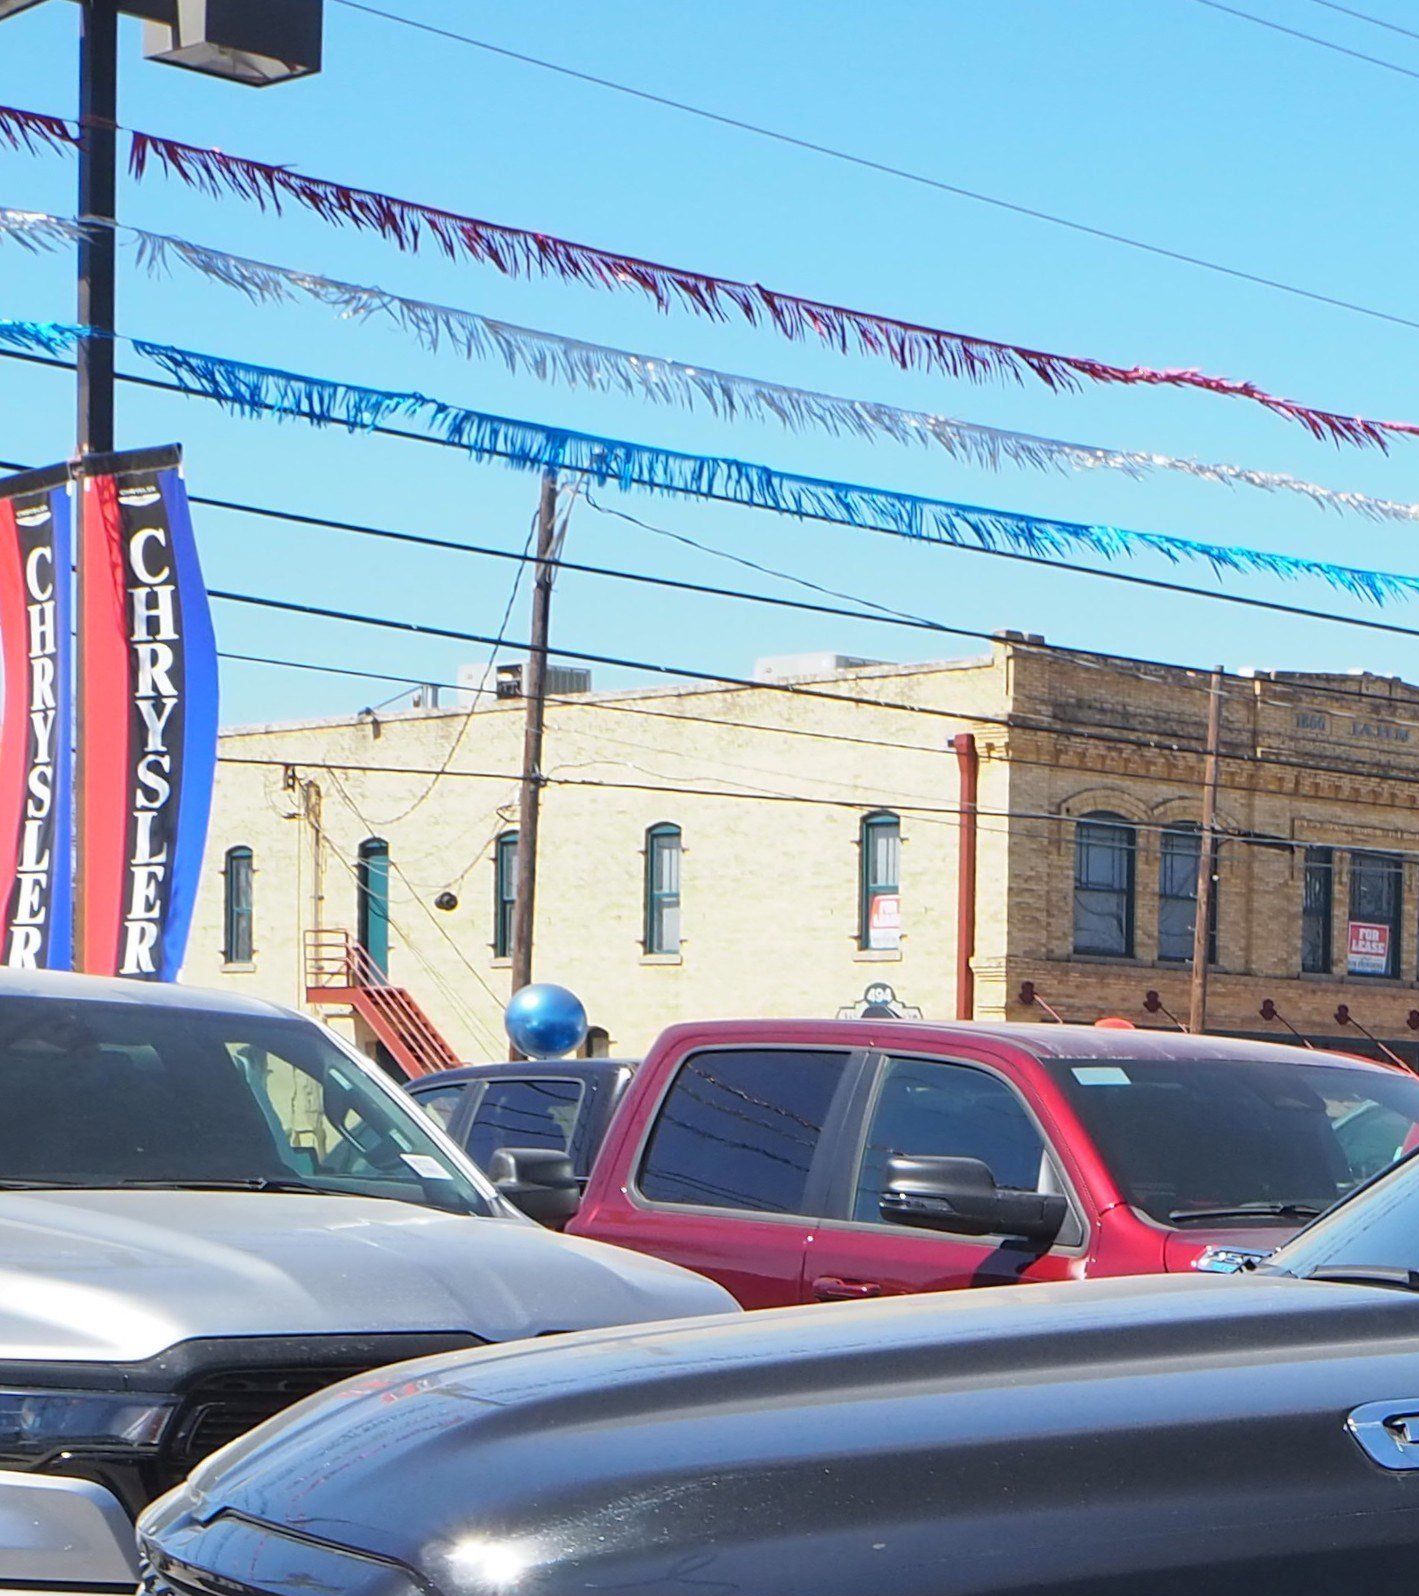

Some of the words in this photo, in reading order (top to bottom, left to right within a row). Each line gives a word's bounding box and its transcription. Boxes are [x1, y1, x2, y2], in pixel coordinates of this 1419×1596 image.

[9, 546, 57, 970] CHRYSLER
[119, 528, 181, 975] CHRYSLER
[1359, 928, 1379, 941] FOR
[1352, 939, 1385, 954] LEASE
[866, 987, 893, 1003] 494
